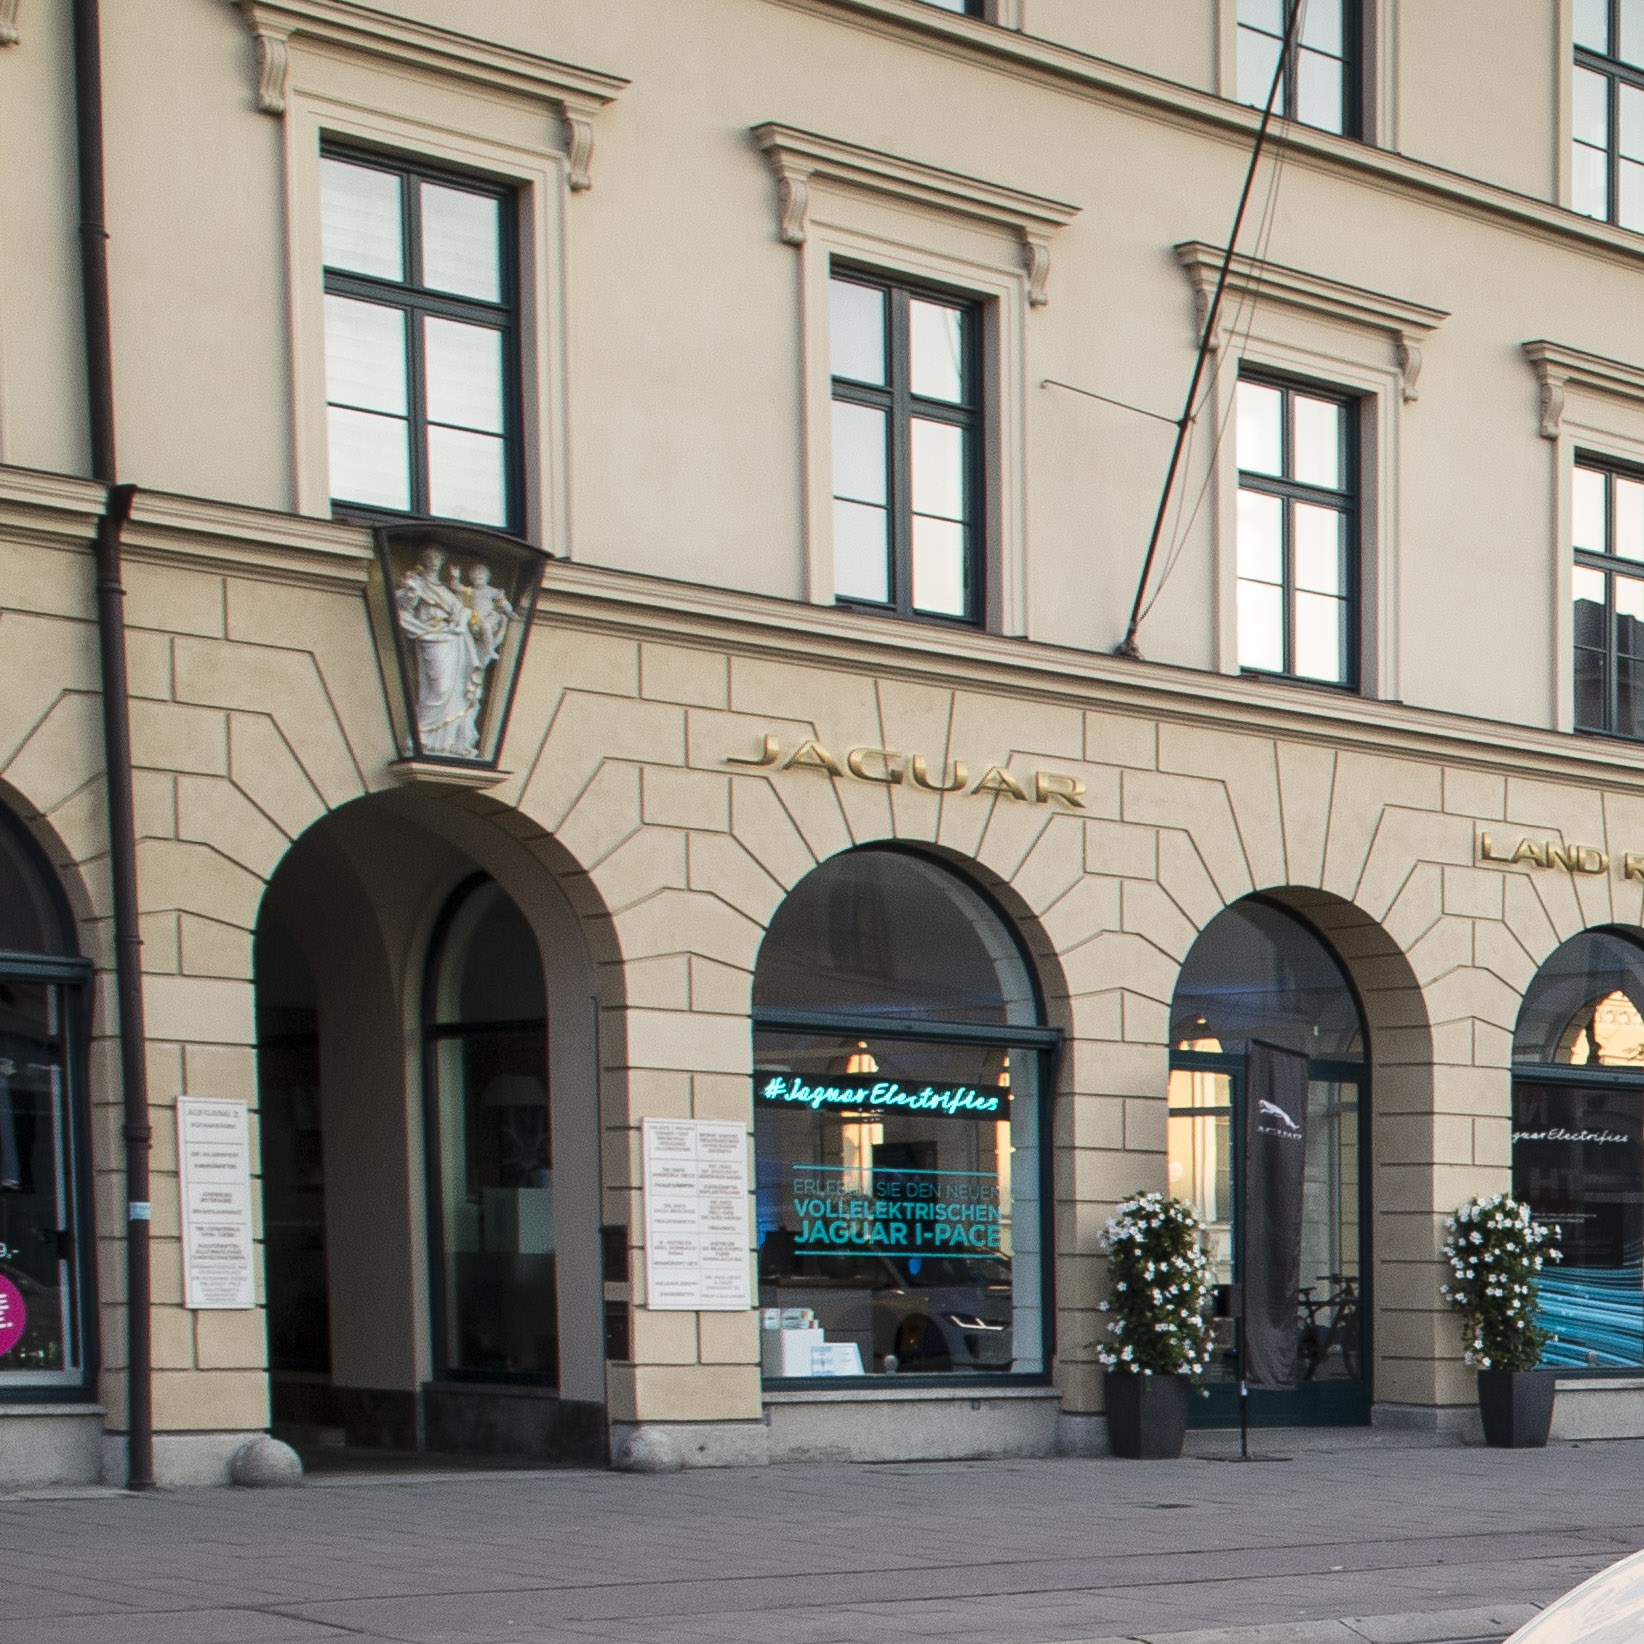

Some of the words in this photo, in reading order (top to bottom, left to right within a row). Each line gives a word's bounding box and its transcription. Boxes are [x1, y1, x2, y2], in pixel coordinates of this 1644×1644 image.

[723, 734, 1087, 808] JAGUAR
[1481, 831, 1609, 875] LAND
[763, 1076, 999, 1114] #JaguarElectrifies
[876, 1182, 901, 1197] SIE
[906, 1183, 941, 1199] DEN
[793, 1199, 1002, 1221] VOLLELEKTRISCHEN
[794, 1220, 908, 1245] JAGUAR
[916, 1223, 1001, 1247] I-PACE
